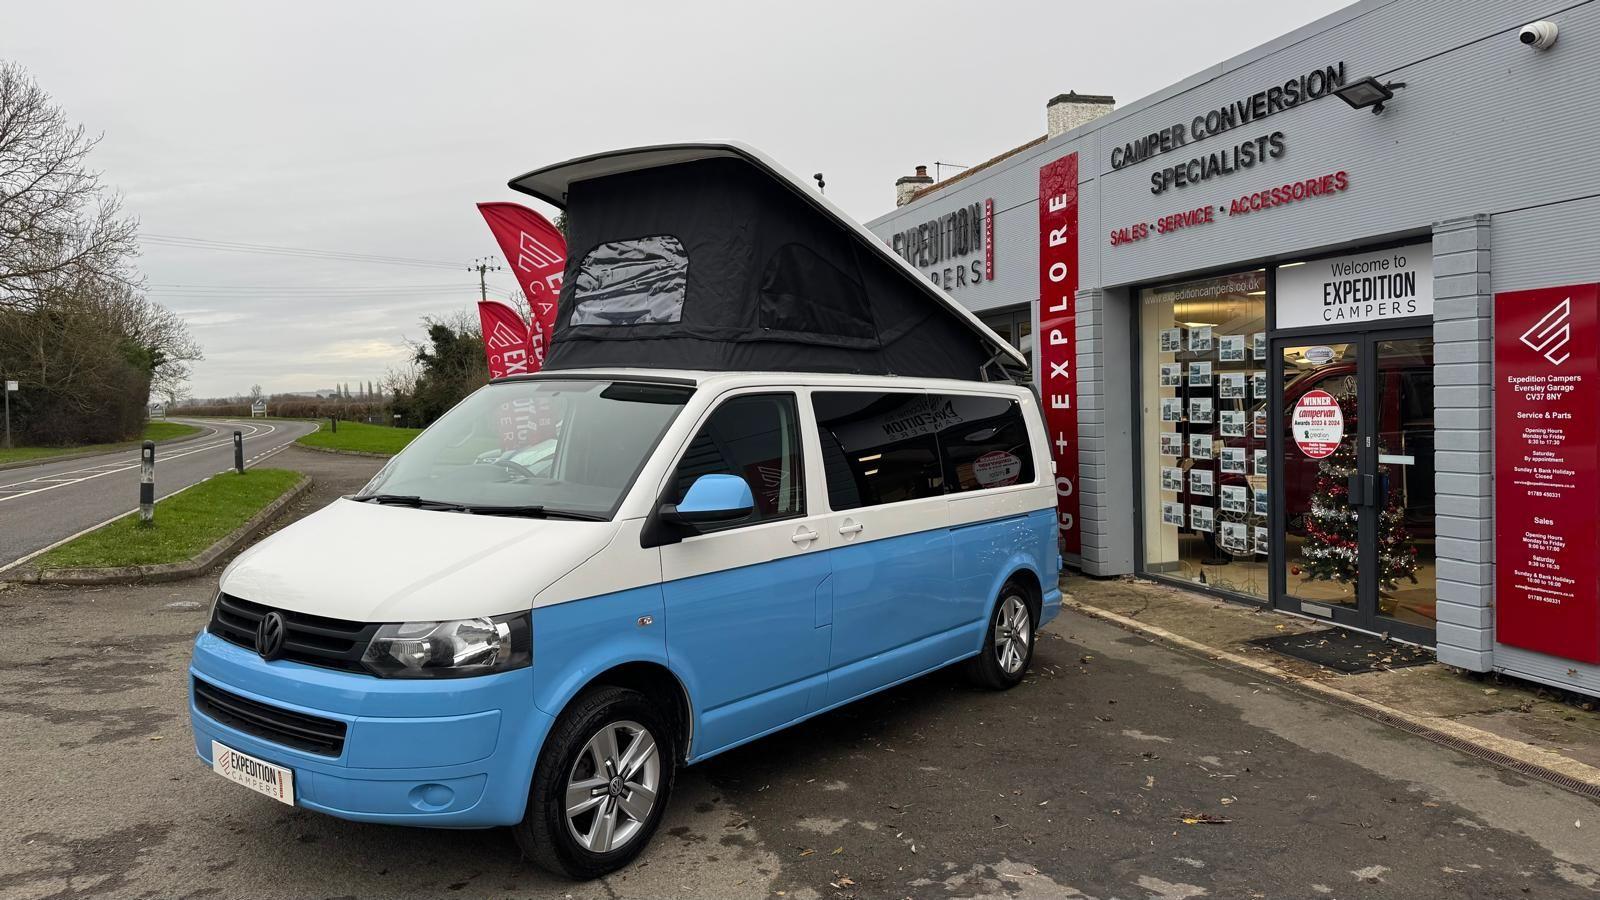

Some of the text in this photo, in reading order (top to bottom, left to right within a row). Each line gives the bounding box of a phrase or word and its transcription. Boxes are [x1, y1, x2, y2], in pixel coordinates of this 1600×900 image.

[1110, 61, 1344, 170] CAMPER CONVERSION
[1150, 131, 1285, 195] SPECIALISTS
[1110, 170, 1348, 246] SALES SERVICE ACCESSORIES
[1331, 254, 1407, 277] Welcome to
[931, 260, 982, 291] PERS
[1323, 271, 1416, 306] EXPEDITION
[1049, 193, 1070, 409] EXPLORE
[1323, 299, 1417, 322] CAMPERS
[1507, 374, 1582, 384] Expedition Campers
[1514, 383, 1575, 393] Eversley Garage
[1303, 396, 1331, 406] WINNER
[1525, 393, 1562, 401] CV37 8NY
[1516, 411, 1572, 419] Service & Parts
[1513, 466, 1533, 474] Sunday
[1552, 468, 1576, 476] Holidays
[1534, 516, 1554, 526] Sales
[1522, 537, 1542, 545] Monday
[1549, 540, 1566, 548] Friday
[1525, 531, 1547, 540] Opening
[1532, 554, 1555, 564] Saturday
[1514, 569, 1533, 578] Sunday
[1552, 575, 1576, 584] Holidays
[230, 752, 277, 785] EXPEDITION
[231, 770, 278, 796] CAMPERS
